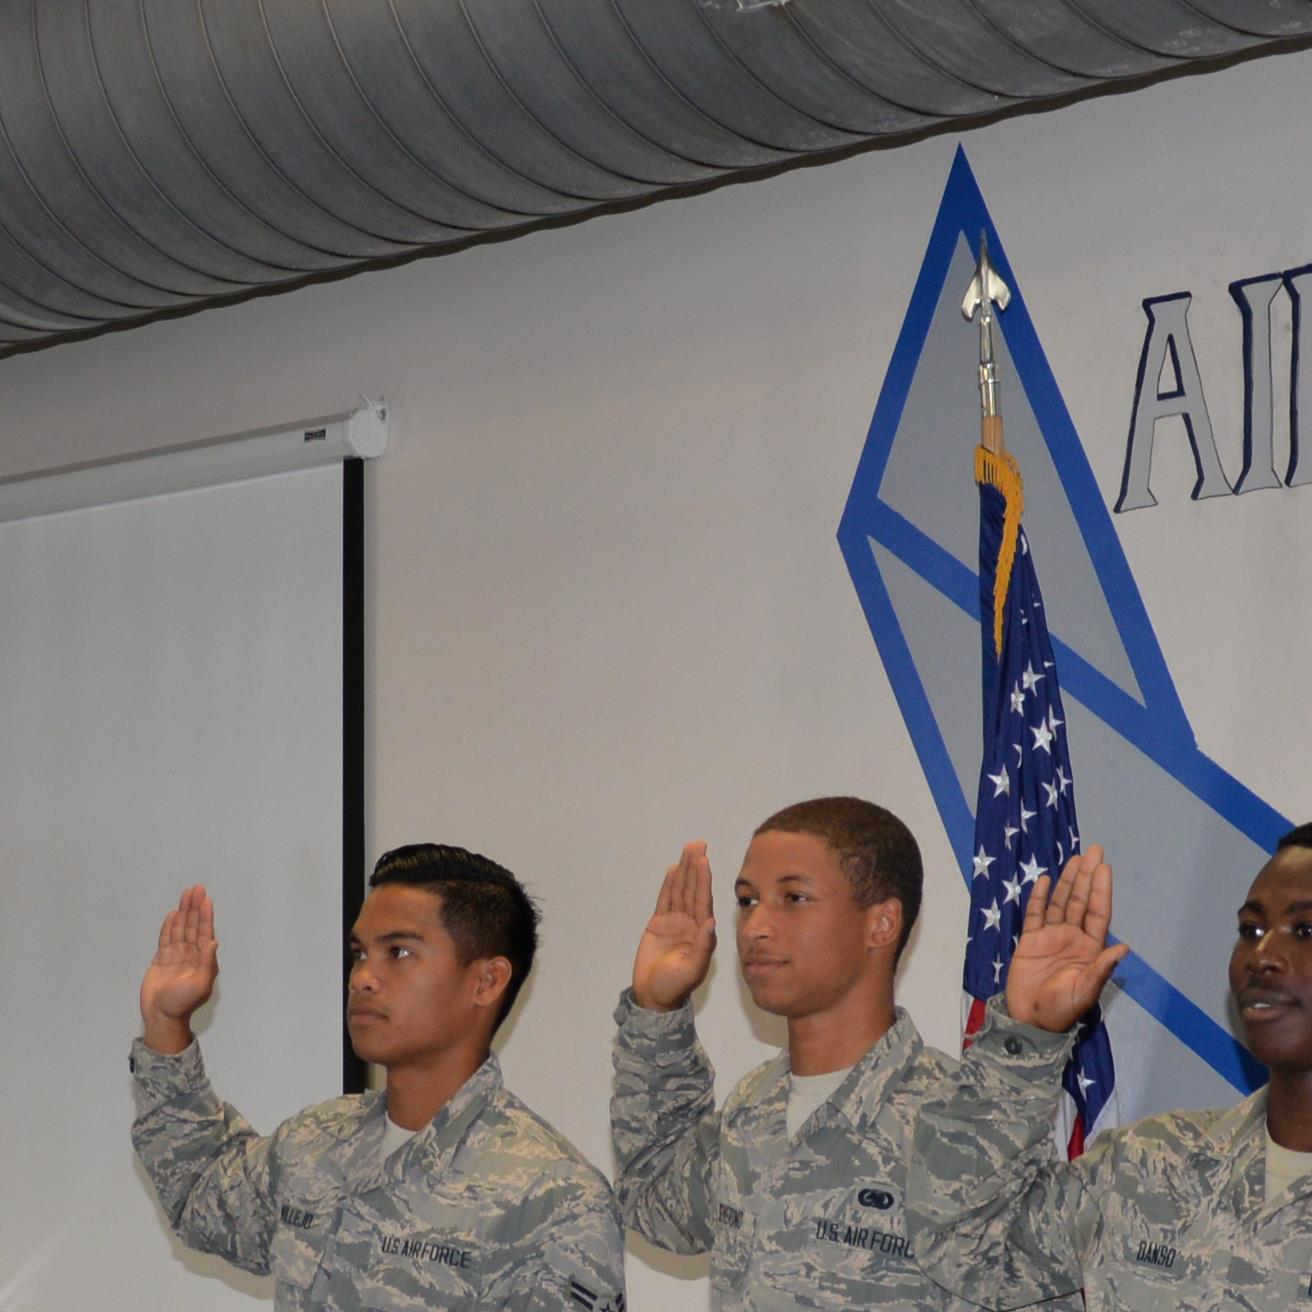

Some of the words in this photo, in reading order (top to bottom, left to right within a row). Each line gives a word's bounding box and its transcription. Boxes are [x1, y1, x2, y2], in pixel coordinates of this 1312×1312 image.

[843, 1226, 868, 1249] AIR
[401, 1239, 422, 1259] AIR
[421, 1241, 472, 1269] FORCE
[1136, 1241, 1177, 1268] DANSO
